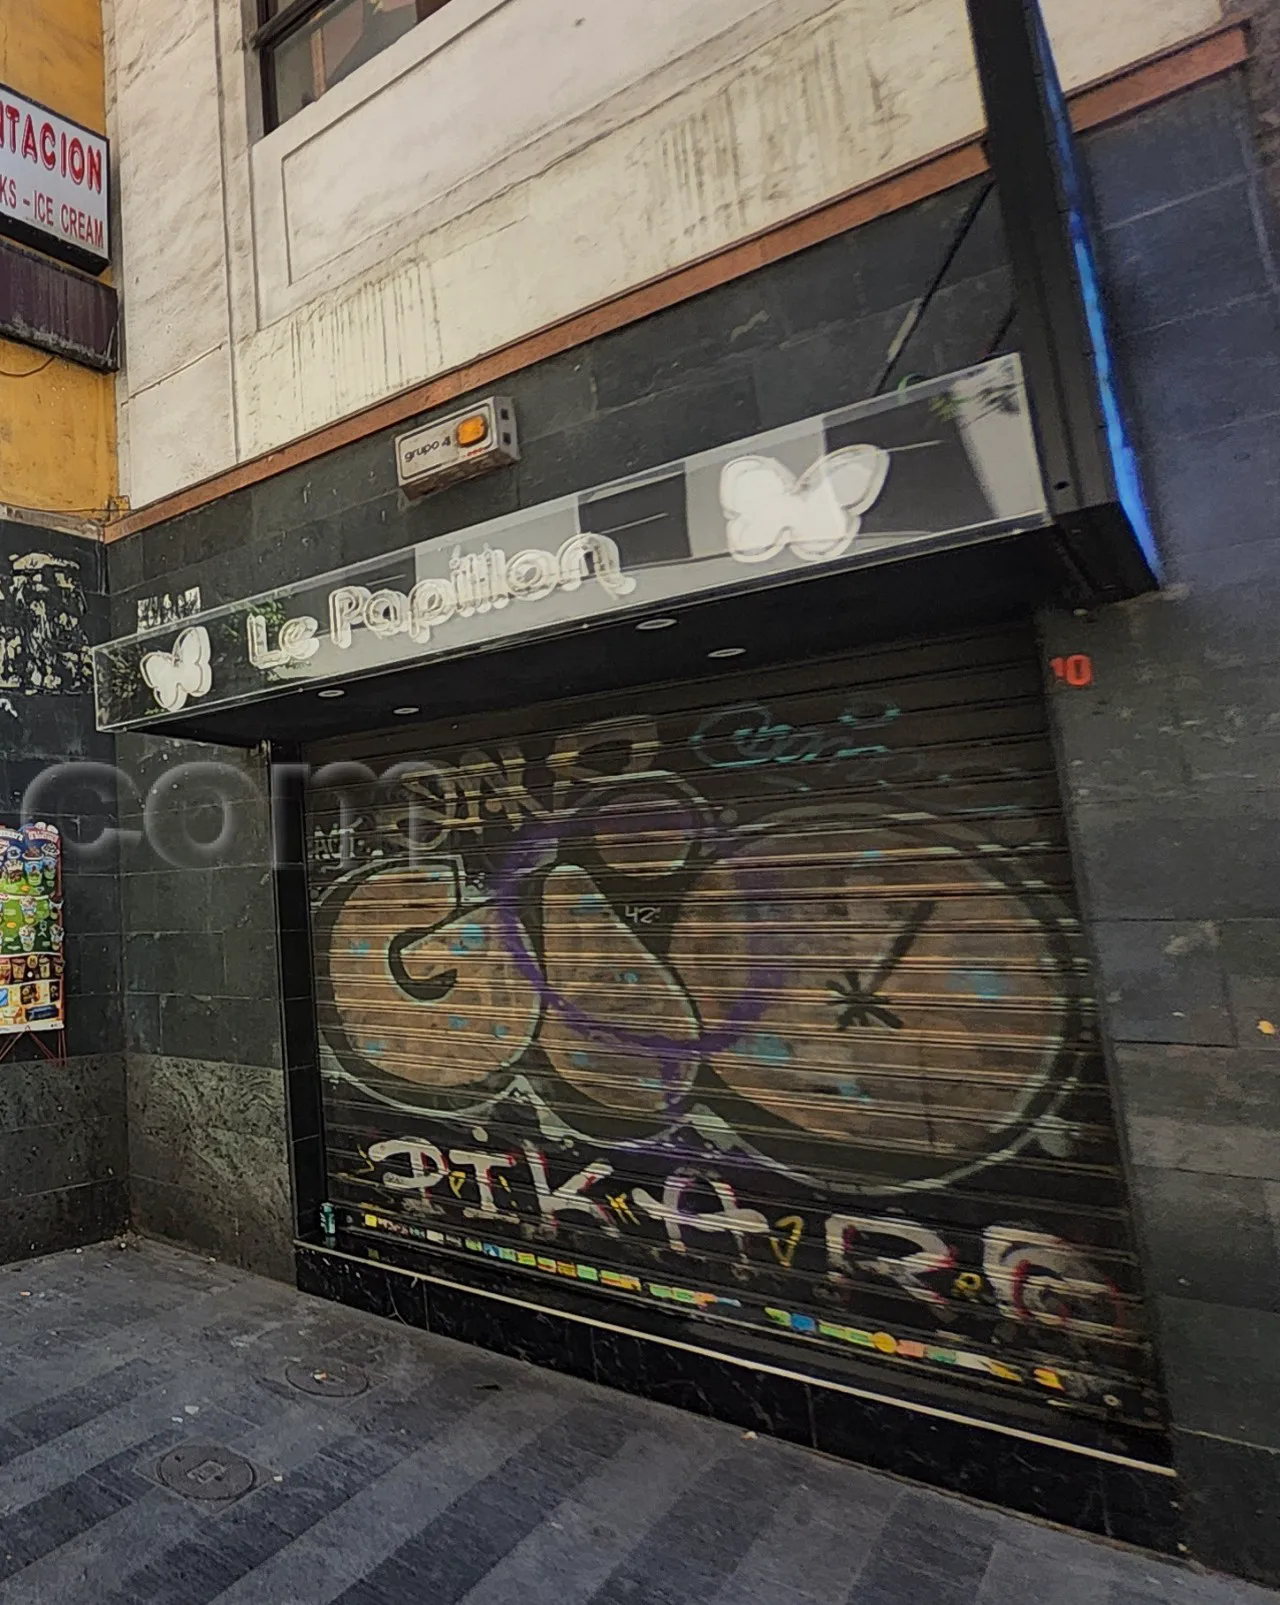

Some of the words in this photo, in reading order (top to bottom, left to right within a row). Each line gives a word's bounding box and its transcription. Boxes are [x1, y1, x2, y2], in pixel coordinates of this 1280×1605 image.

[34, 190, 54, 226] ICE
[60, 204, 104, 249] CREAM
[404, 441, 440, 463] grupo
[441, 436, 451, 447] 4
[246, 613, 320, 669] Le
[329, 532, 637, 649] Papillon
